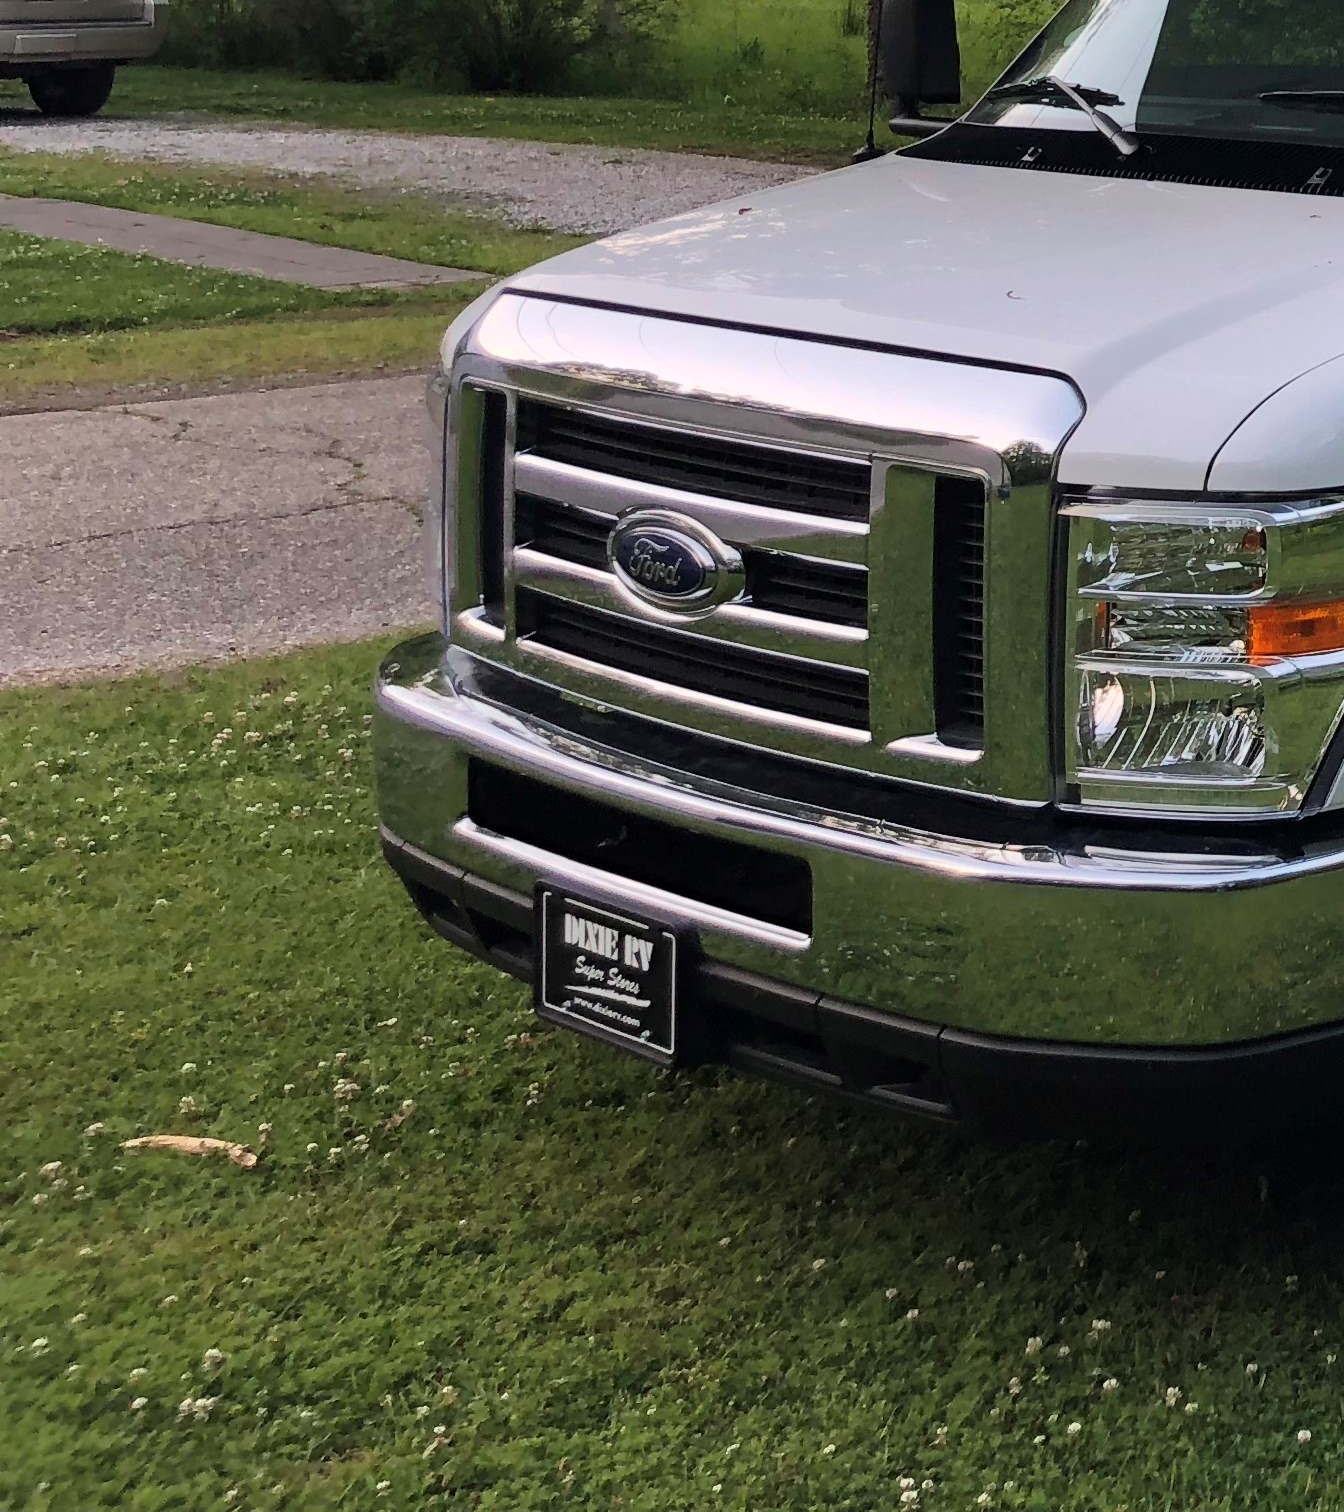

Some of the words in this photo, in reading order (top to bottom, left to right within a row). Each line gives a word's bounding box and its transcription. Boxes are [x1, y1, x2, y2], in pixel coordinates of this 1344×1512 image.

[628, 538, 683, 587] Ford
[564, 913, 619, 961] DIXIE
[624, 933, 654, 972] RV
[574, 955, 605, 982] Super
